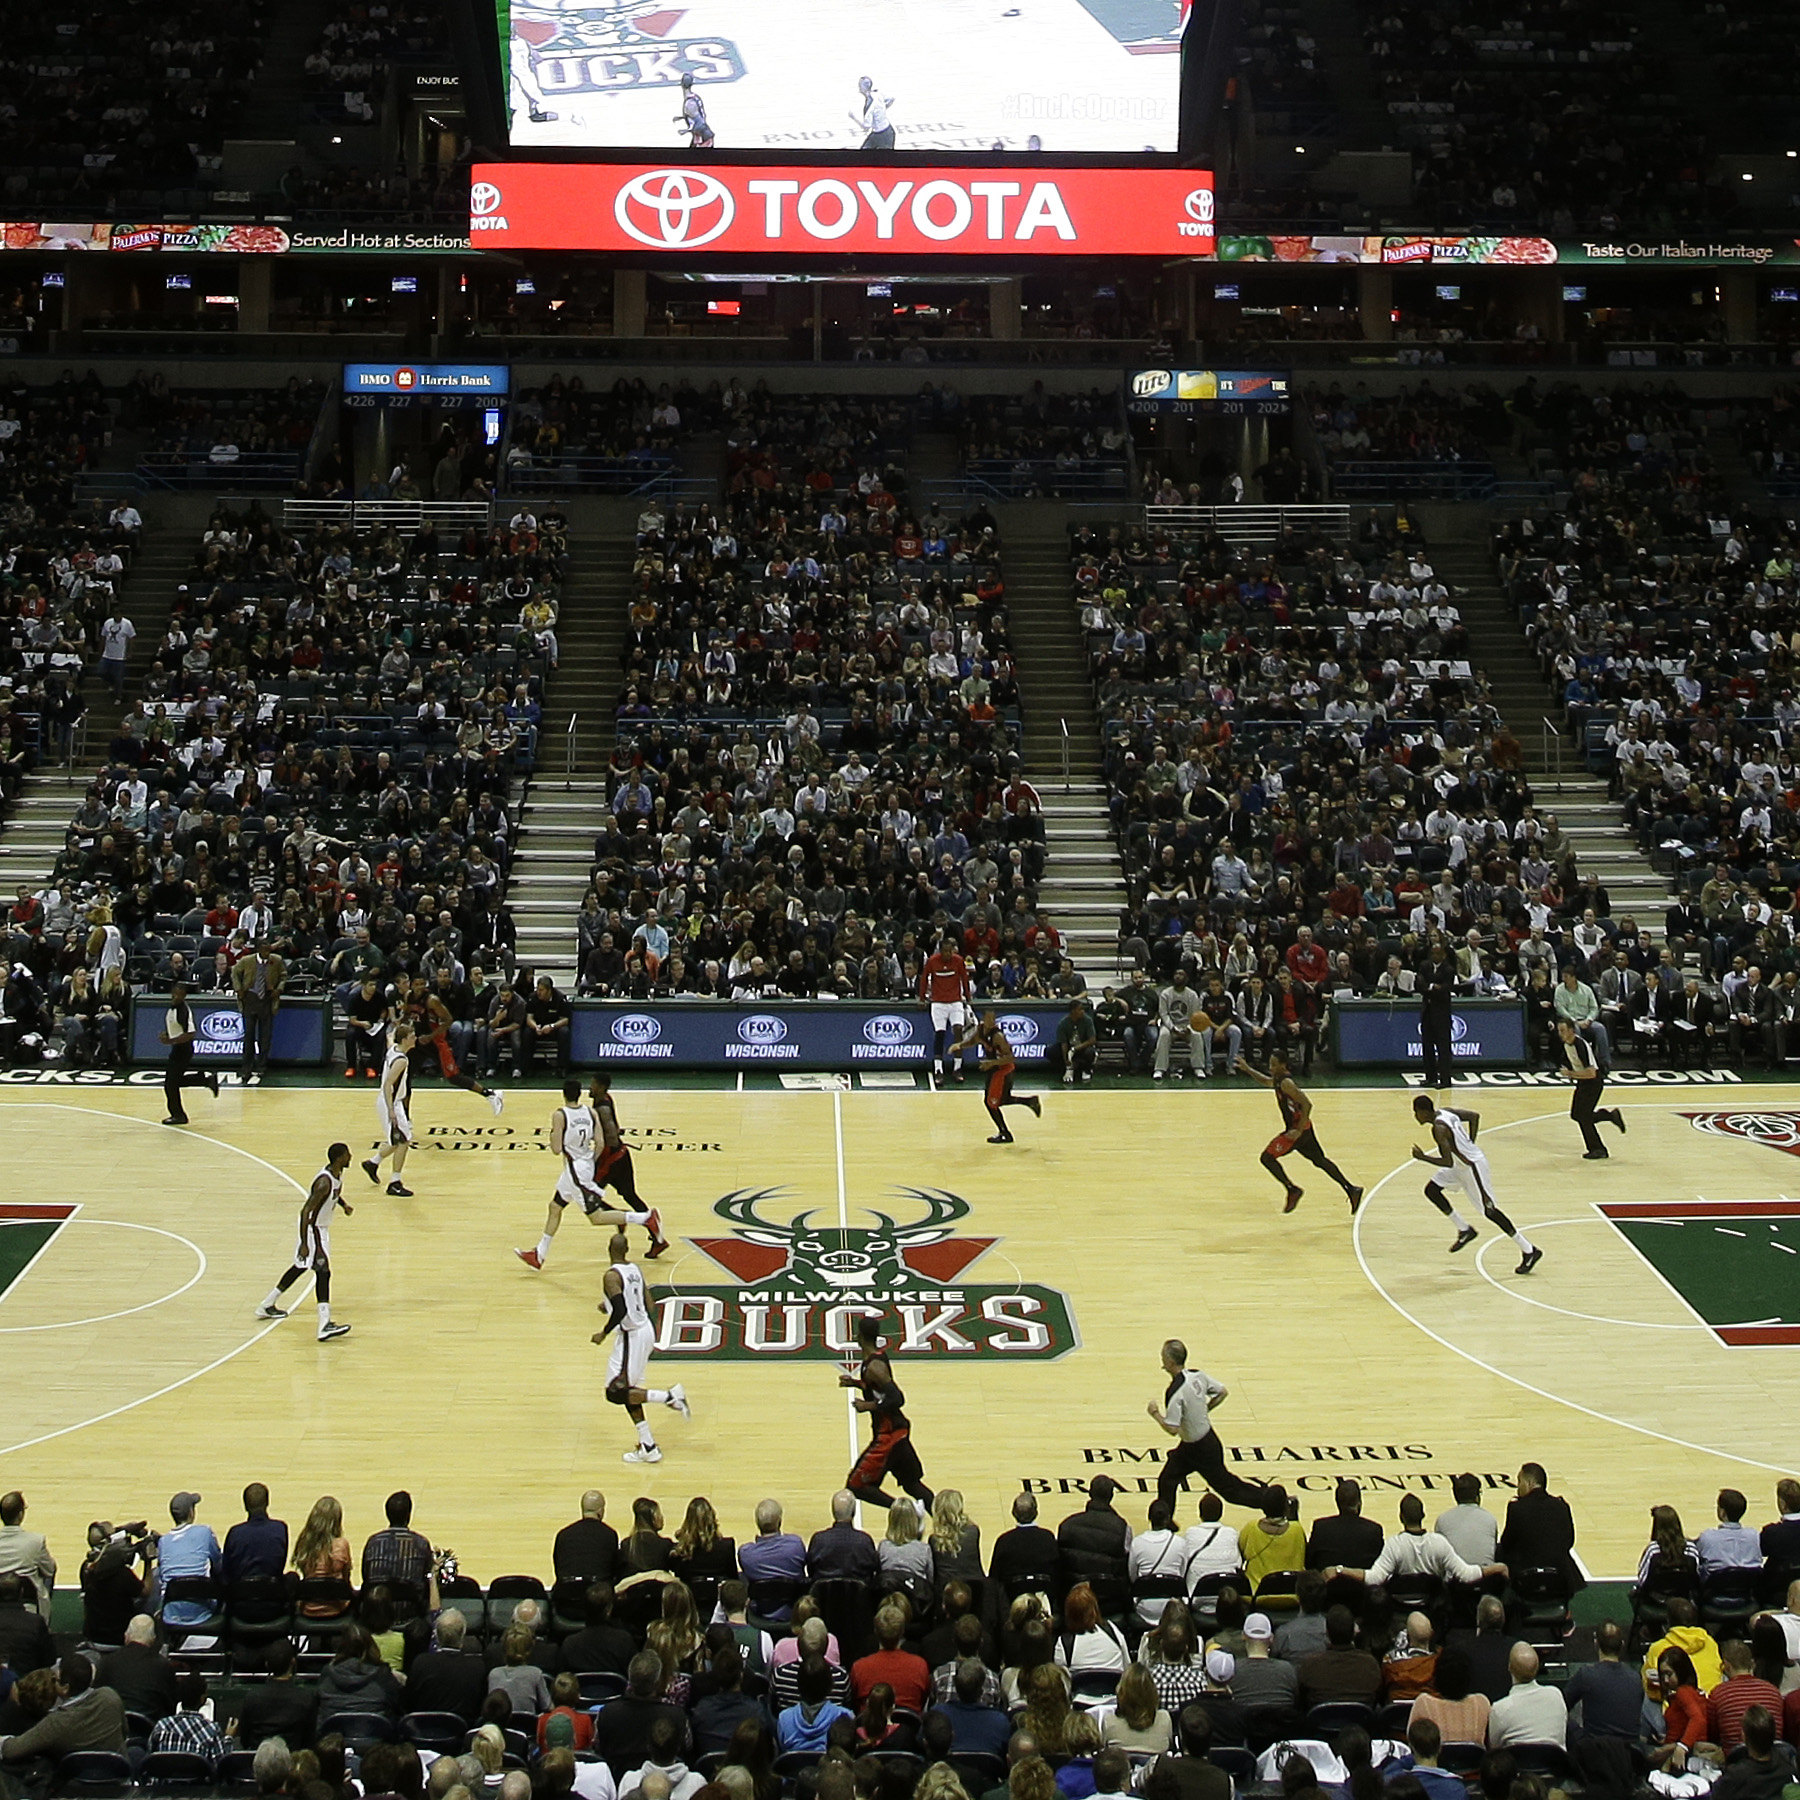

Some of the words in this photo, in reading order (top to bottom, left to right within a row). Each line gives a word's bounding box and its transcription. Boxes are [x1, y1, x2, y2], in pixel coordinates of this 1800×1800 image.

[748, 179, 1077, 240] TOYOTA
[292, 228, 347, 248] Served
[351, 234, 381, 248] Hot
[384, 236, 400, 248] at
[403, 234, 471, 249] Sections
[1433, 246, 1469, 257] PIZZA
[1582, 243, 1625, 258] Taste
[1626, 243, 1658, 258] Our
[1661, 239, 1706, 258] Italian
[1708, 244, 1774, 264] Heritage
[360, 374, 391, 385] BMO
[420, 374, 458, 386] Harris
[461, 375, 491, 386] Bank
[1135, 403, 1159, 413] 200
[1172, 403, 1194, 413] 201
[1223, 403, 1245, 413] 201
[1258, 403, 1280, 413] 202
[616, 1016, 656, 1031] FOX
[598, 1043, 675, 1058] WISCONSIN
[725, 1044, 800, 1058] WISCONSIN
[738, 1291, 966, 1302] MILWAUKEE
[655, 1294, 1052, 1354] BUCKS
[1226, 1444, 1435, 1462] HARRIS
